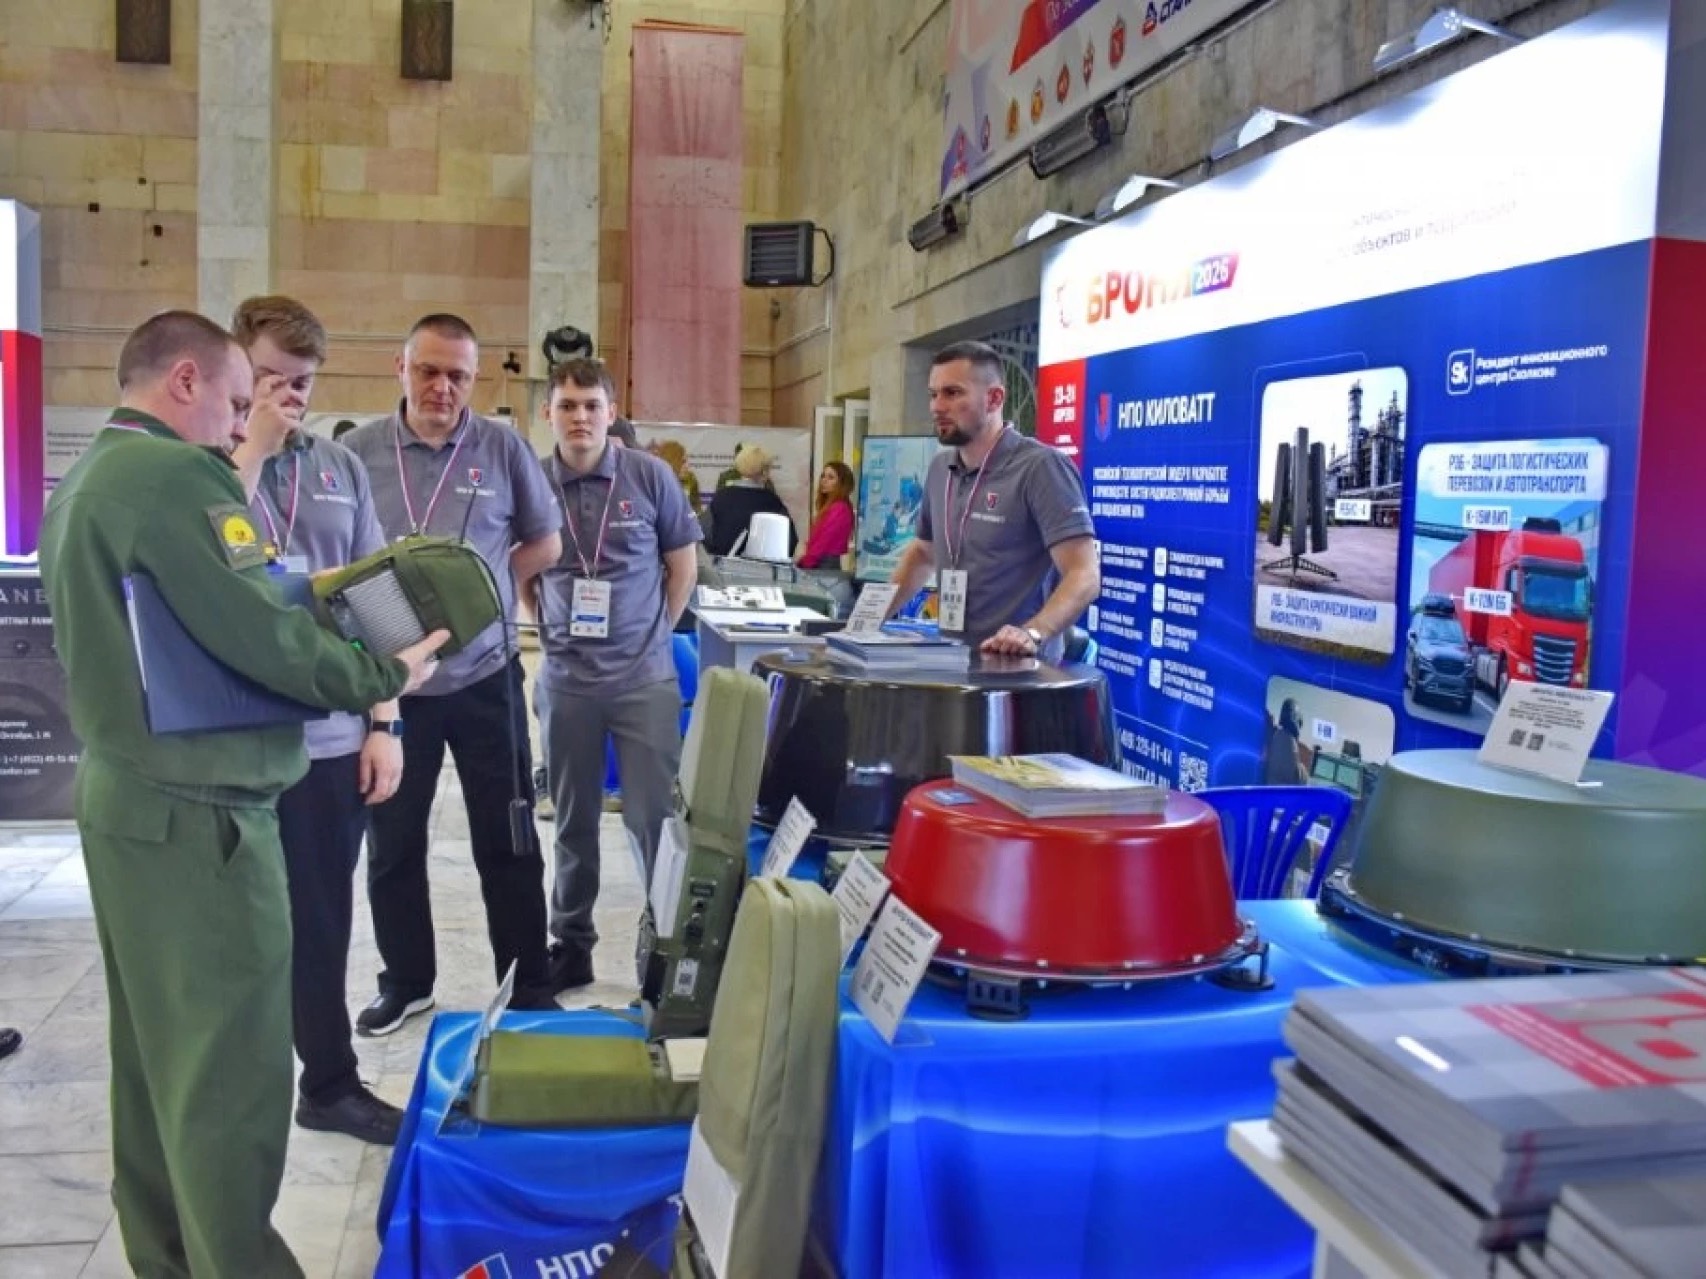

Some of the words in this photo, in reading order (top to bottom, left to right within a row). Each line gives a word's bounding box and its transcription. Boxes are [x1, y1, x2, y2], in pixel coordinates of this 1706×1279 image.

[1476, 355, 1521, 370] Резидент
[1521, 345, 1608, 366] инновационного
[1475, 371, 1508, 387] центра
[1508, 366, 1557, 382] Сколково
[1118, 400, 1142, 429] НПО
[1144, 392, 1216, 427] КИЛОВАТТ
[1449, 454, 1465, 471] РЭБ
[1471, 453, 1507, 472] ЗАЩИТА
[1509, 451, 1589, 471] ЛОГИСТИЧЕСКИХ
[1447, 475, 1493, 493] ПЕРЕВОЗОК
[1495, 475, 1502, 492] И
[1503, 474, 1587, 493] АВТОТРАНСПОРТА
